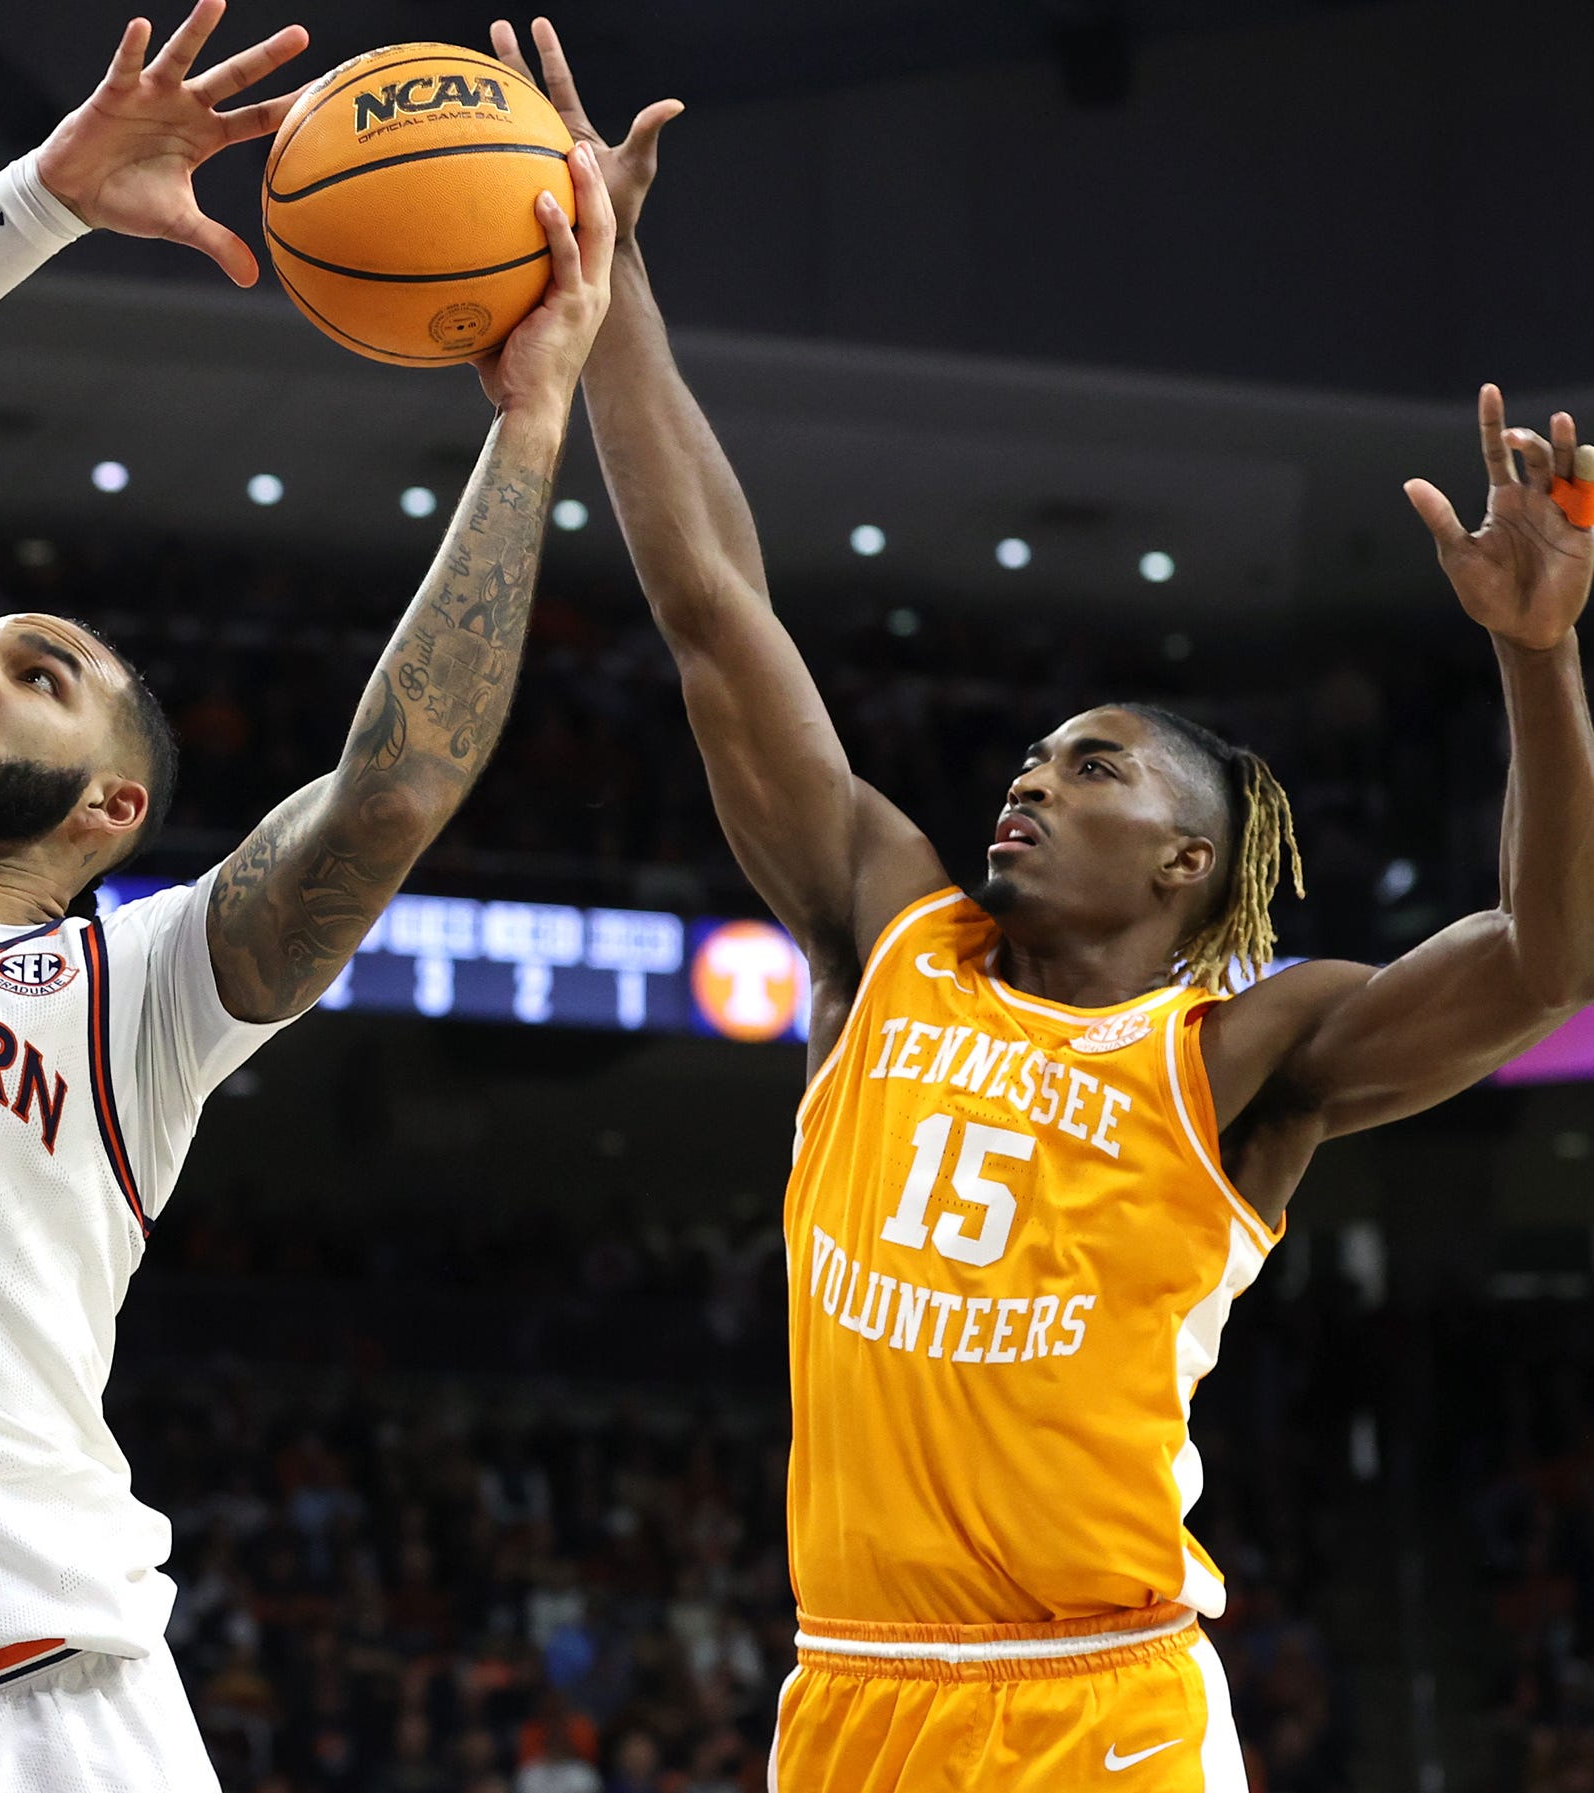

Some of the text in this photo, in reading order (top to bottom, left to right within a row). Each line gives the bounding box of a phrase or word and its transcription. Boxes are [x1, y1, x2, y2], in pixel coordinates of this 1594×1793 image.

[353, 75, 511, 135] NCAA
[358, 111, 513, 144] OFFICIAL GAME BALL
[399, 627, 437, 701] Built
[430, 584, 456, 630] for
[448, 543, 471, 578] the
[2, 954, 60, 984] SEC
[1089, 1013, 1146, 1042] SEC
[869, 1016, 1132, 1159] TENNESSEE
[880, 1112, 1037, 1268] 15
[810, 1223, 1097, 1364] VOLUNTEERS
